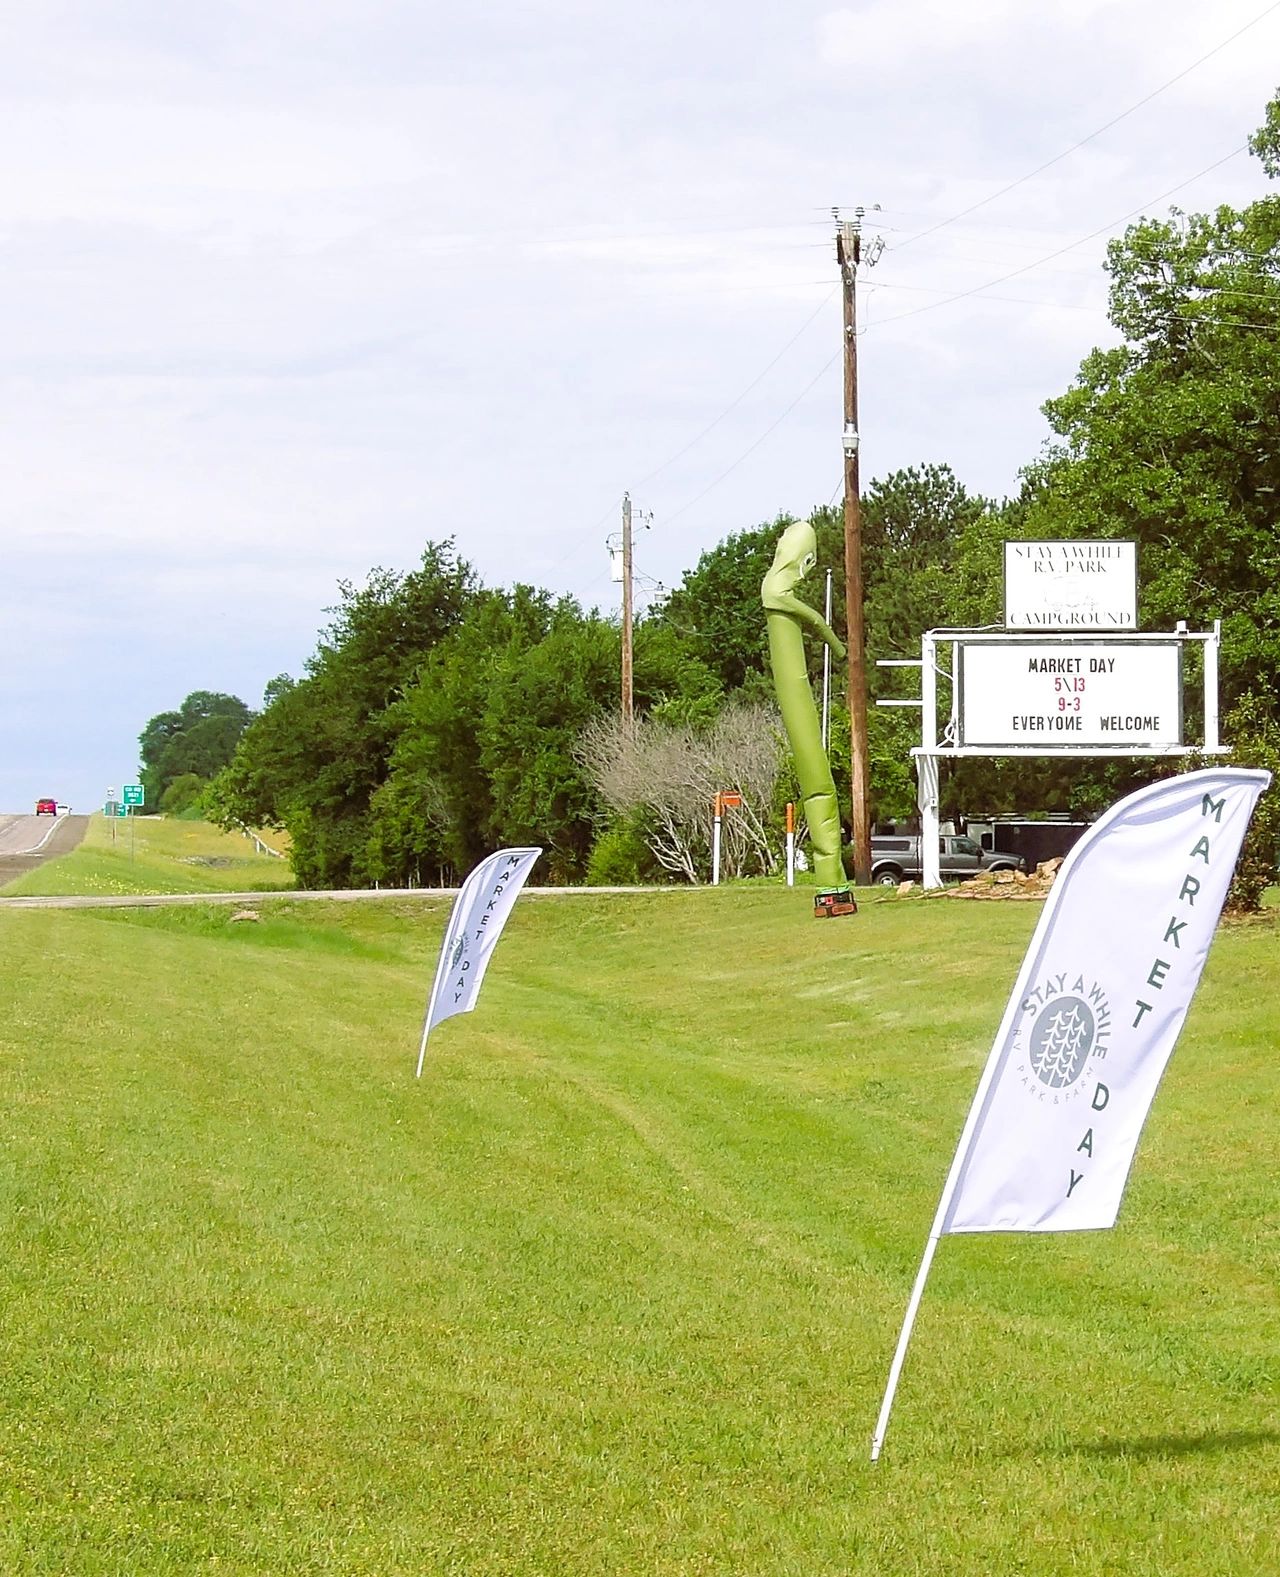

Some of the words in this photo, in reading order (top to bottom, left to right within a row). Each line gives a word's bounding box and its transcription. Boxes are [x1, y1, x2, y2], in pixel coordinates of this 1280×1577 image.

[1015, 545, 1056, 559] STAY
[1066, 560, 1108, 573] PARK
[1010, 612, 1131, 625] CAMPGROUND
[1028, 658, 1082, 673] MARKET
[1089, 658, 1116, 673] DAY
[1054, 677, 1086, 692] 5\13
[1058, 697, 1081, 712] 9-3
[1012, 716, 1083, 731] EVERYONE
[1100, 716, 1160, 731] WELCOME
[475, 856, 520, 941] MARKET
[1130, 792, 1227, 1029] MARKET
[454, 961, 471, 1004] DAY
[1021, 972, 1068, 1017] STAY
[1071, 974, 1084, 994] A
[1088, 981, 1111, 1060] WHILE
[1012, 1028, 1022, 1051] RV
[1017, 1064, 1046, 1101] PARK
[1065, 1081, 1111, 1199] DAY
